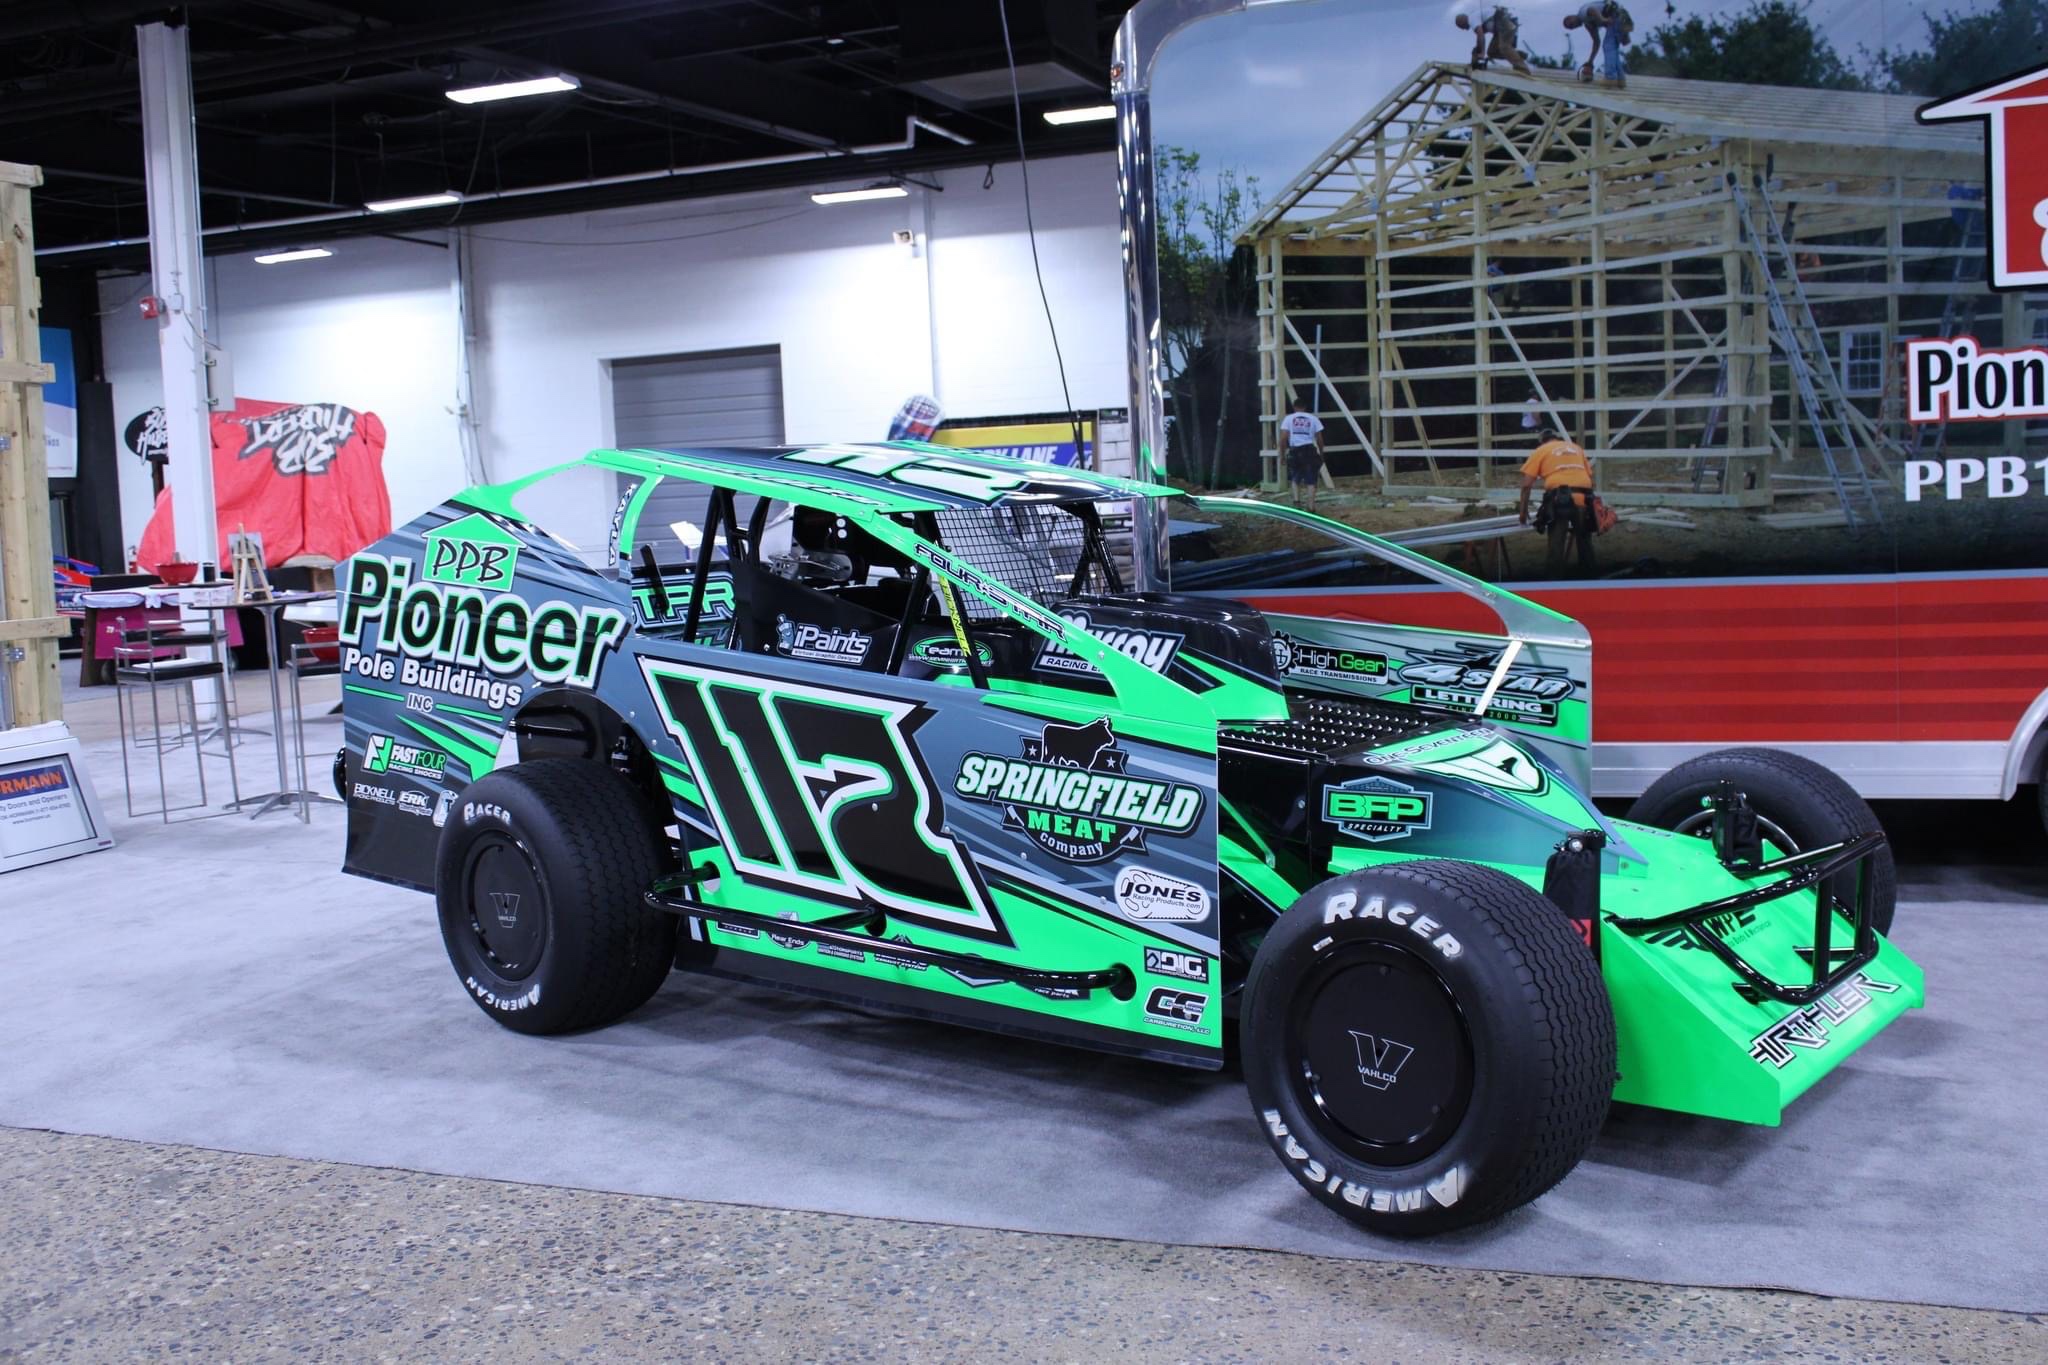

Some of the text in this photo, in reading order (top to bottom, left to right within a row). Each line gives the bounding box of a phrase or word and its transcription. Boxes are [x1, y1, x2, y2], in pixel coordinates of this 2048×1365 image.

[432, 538, 510, 583] PPB
[341, 555, 622, 686] Pioneer
[793, 625, 871, 654] iPaints
[1046, 657, 1089, 671] RACING
[1317, 669, 1378, 683] TRANSMISSIONS
[343, 648, 523, 710] Pole Buildings
[407, 692, 434, 712] INC
[1424, 688, 1543, 713] LETTRING
[956, 755, 1201, 829] SPRINGFIELD
[1329, 792, 1424, 821] BFP
[463, 801, 512, 826] RACER
[1027, 809, 1117, 843] MEAT
[1347, 822, 1403, 834] SPECIALTY
[1119, 881, 1202, 904] JONES
[1323, 889, 1464, 960] RACER
[788, 935, 805, 946] Ends
[465, 975, 542, 1012] AMERICAN
[1358, 1064, 1397, 1083] VAHLCO
[1262, 1107, 1467, 1214] AMERICAN
